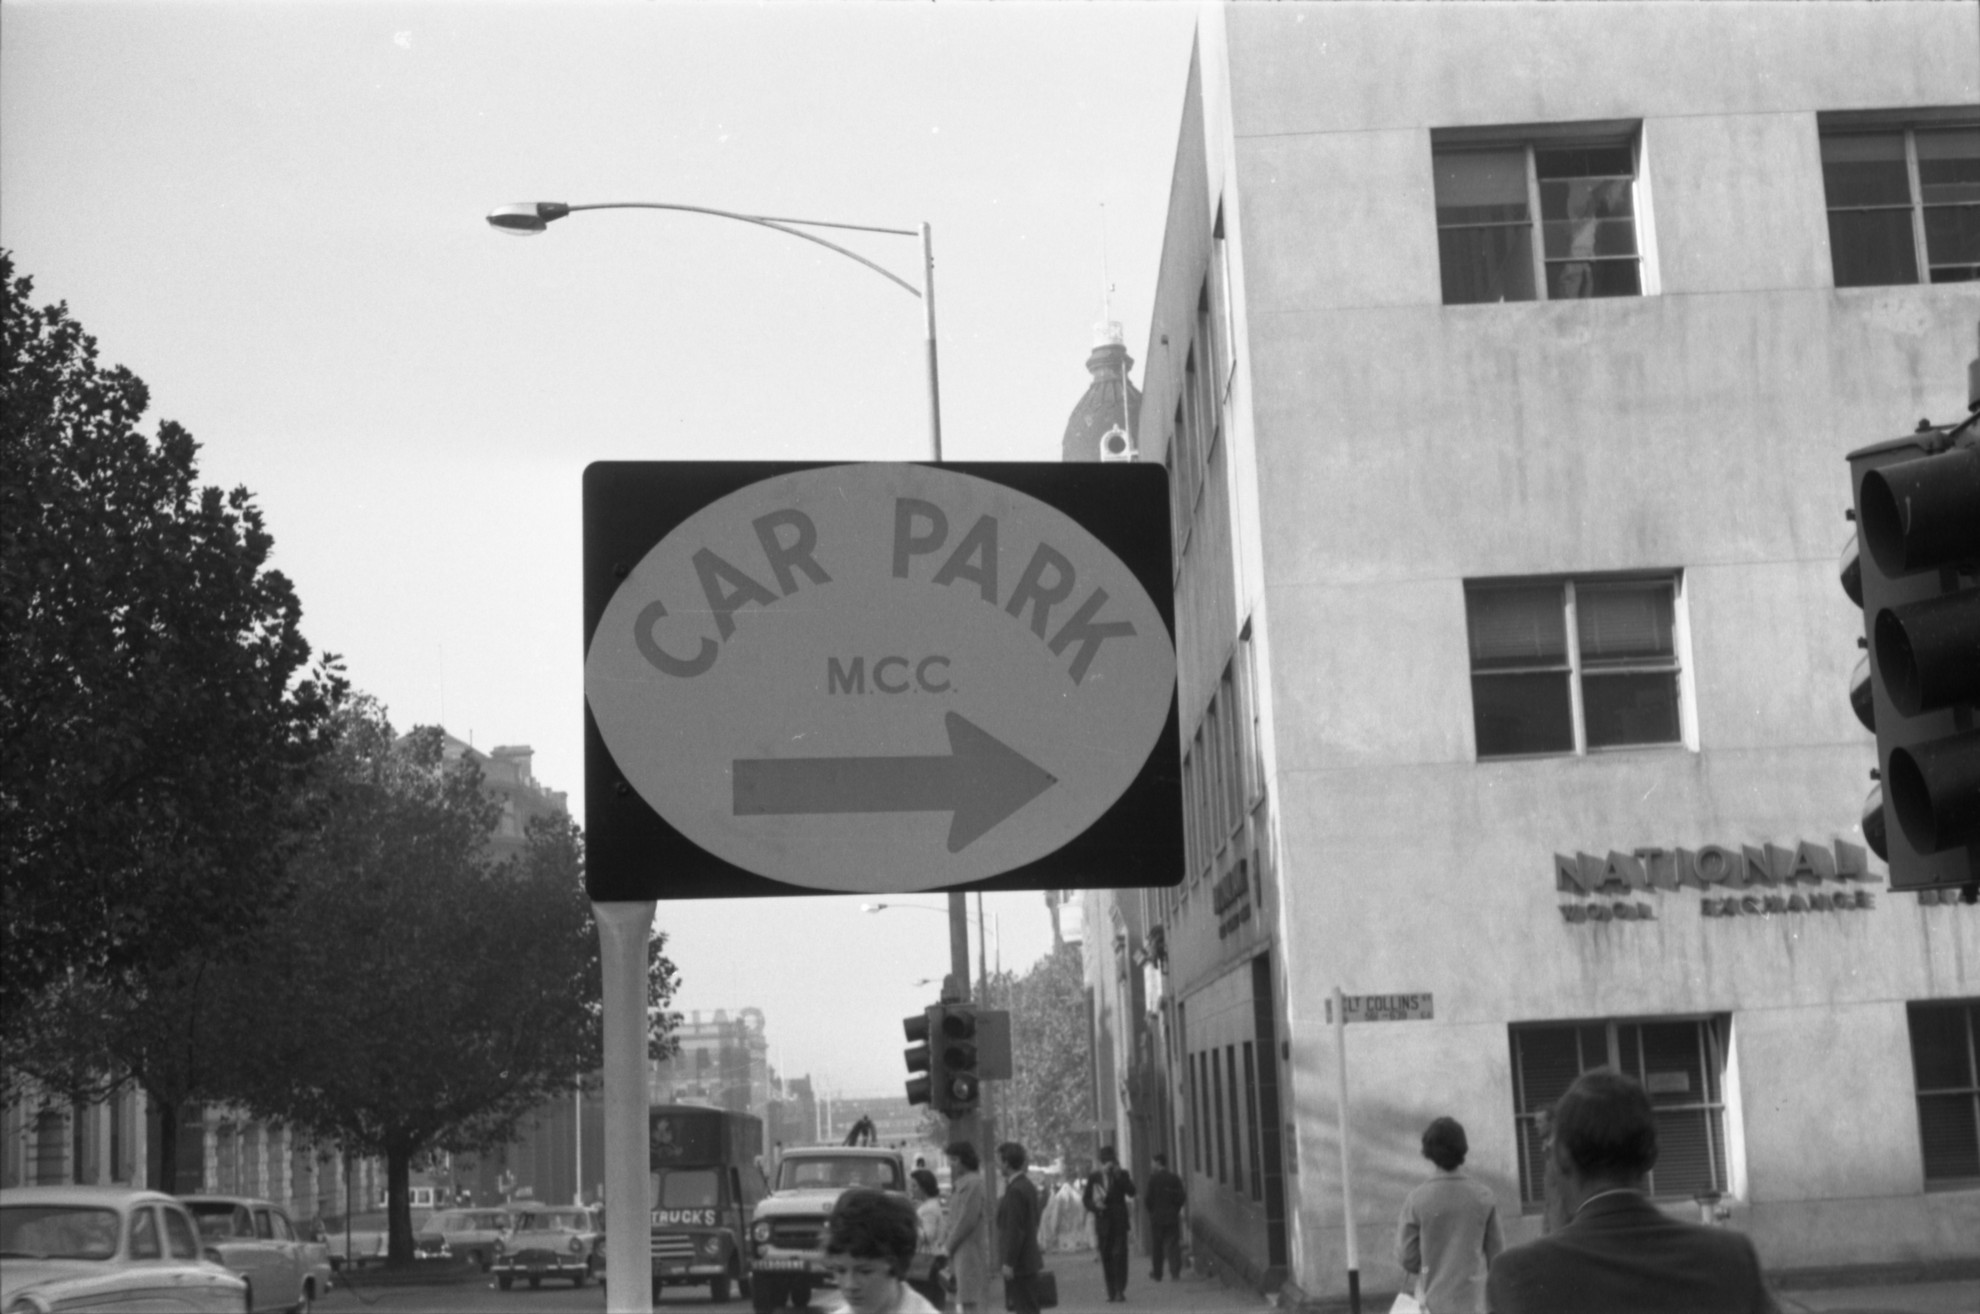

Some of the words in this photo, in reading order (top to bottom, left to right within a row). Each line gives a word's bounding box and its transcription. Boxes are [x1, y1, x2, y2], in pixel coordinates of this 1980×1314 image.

[633, 507, 834, 679] CAR
[891, 496, 1139, 688] PARK
[826, 655, 959, 695] M.C.C.
[1553, 838, 1884, 896] NATIONAL
[1700, 890, 1877, 918] EXCHANGE
[1366, 995, 1420, 1012] COLLINS
[651, 1209, 716, 1226] TRUCKS
